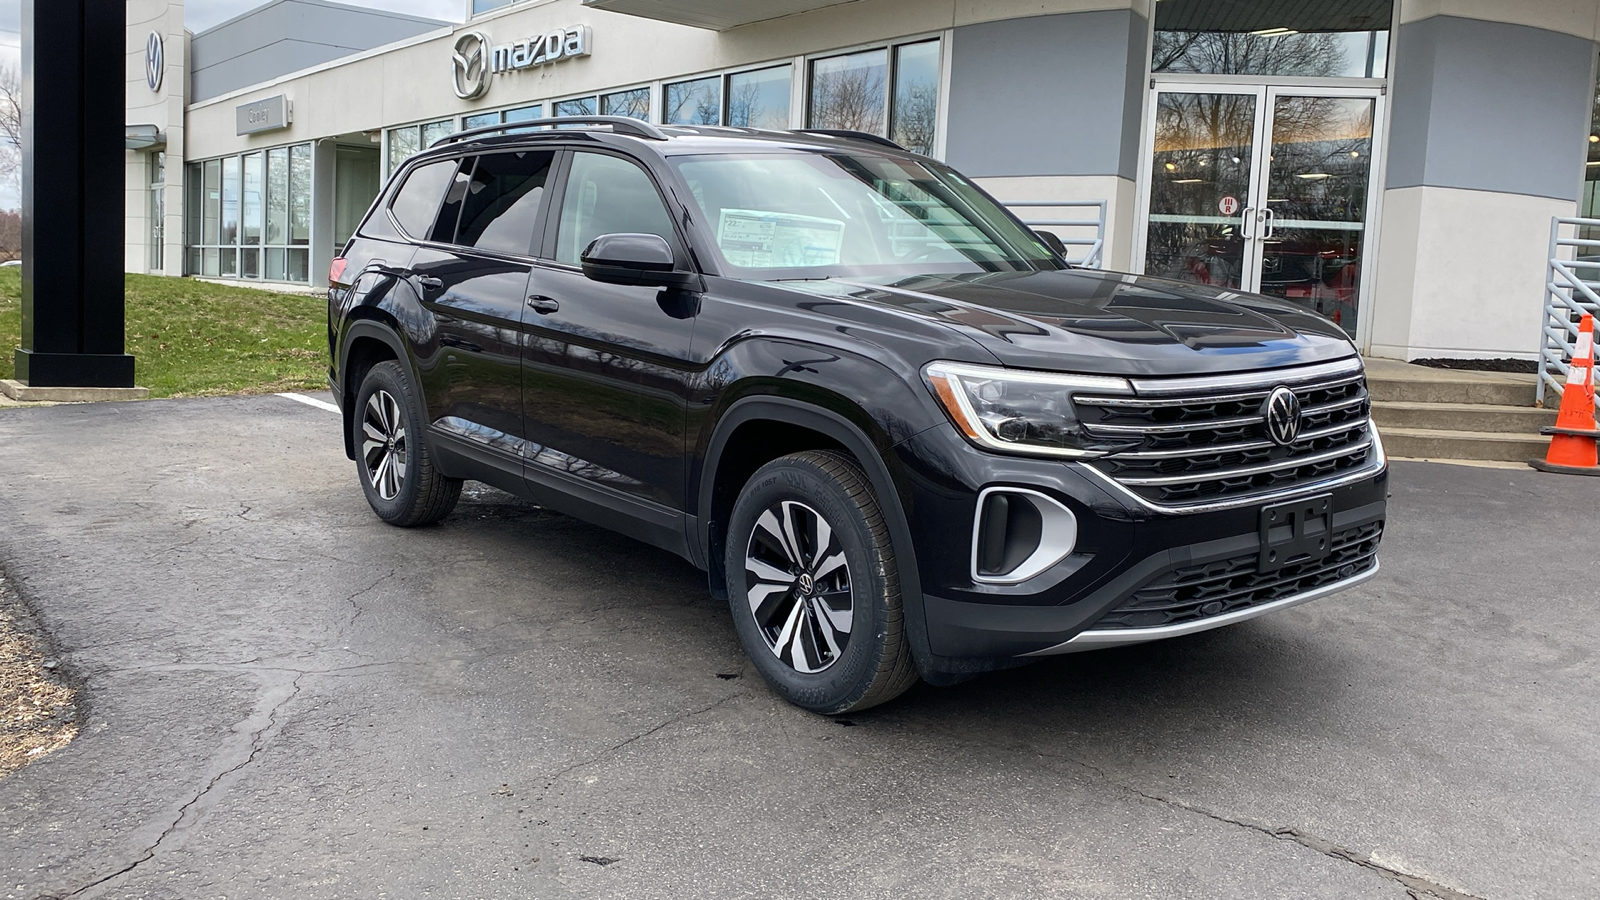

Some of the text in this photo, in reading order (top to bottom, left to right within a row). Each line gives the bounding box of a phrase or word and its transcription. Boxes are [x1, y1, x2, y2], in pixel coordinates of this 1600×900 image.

[491, 24, 590, 74] mazda
[247, 102, 271, 127] Cooley
[762, 476, 777, 488] 105T
